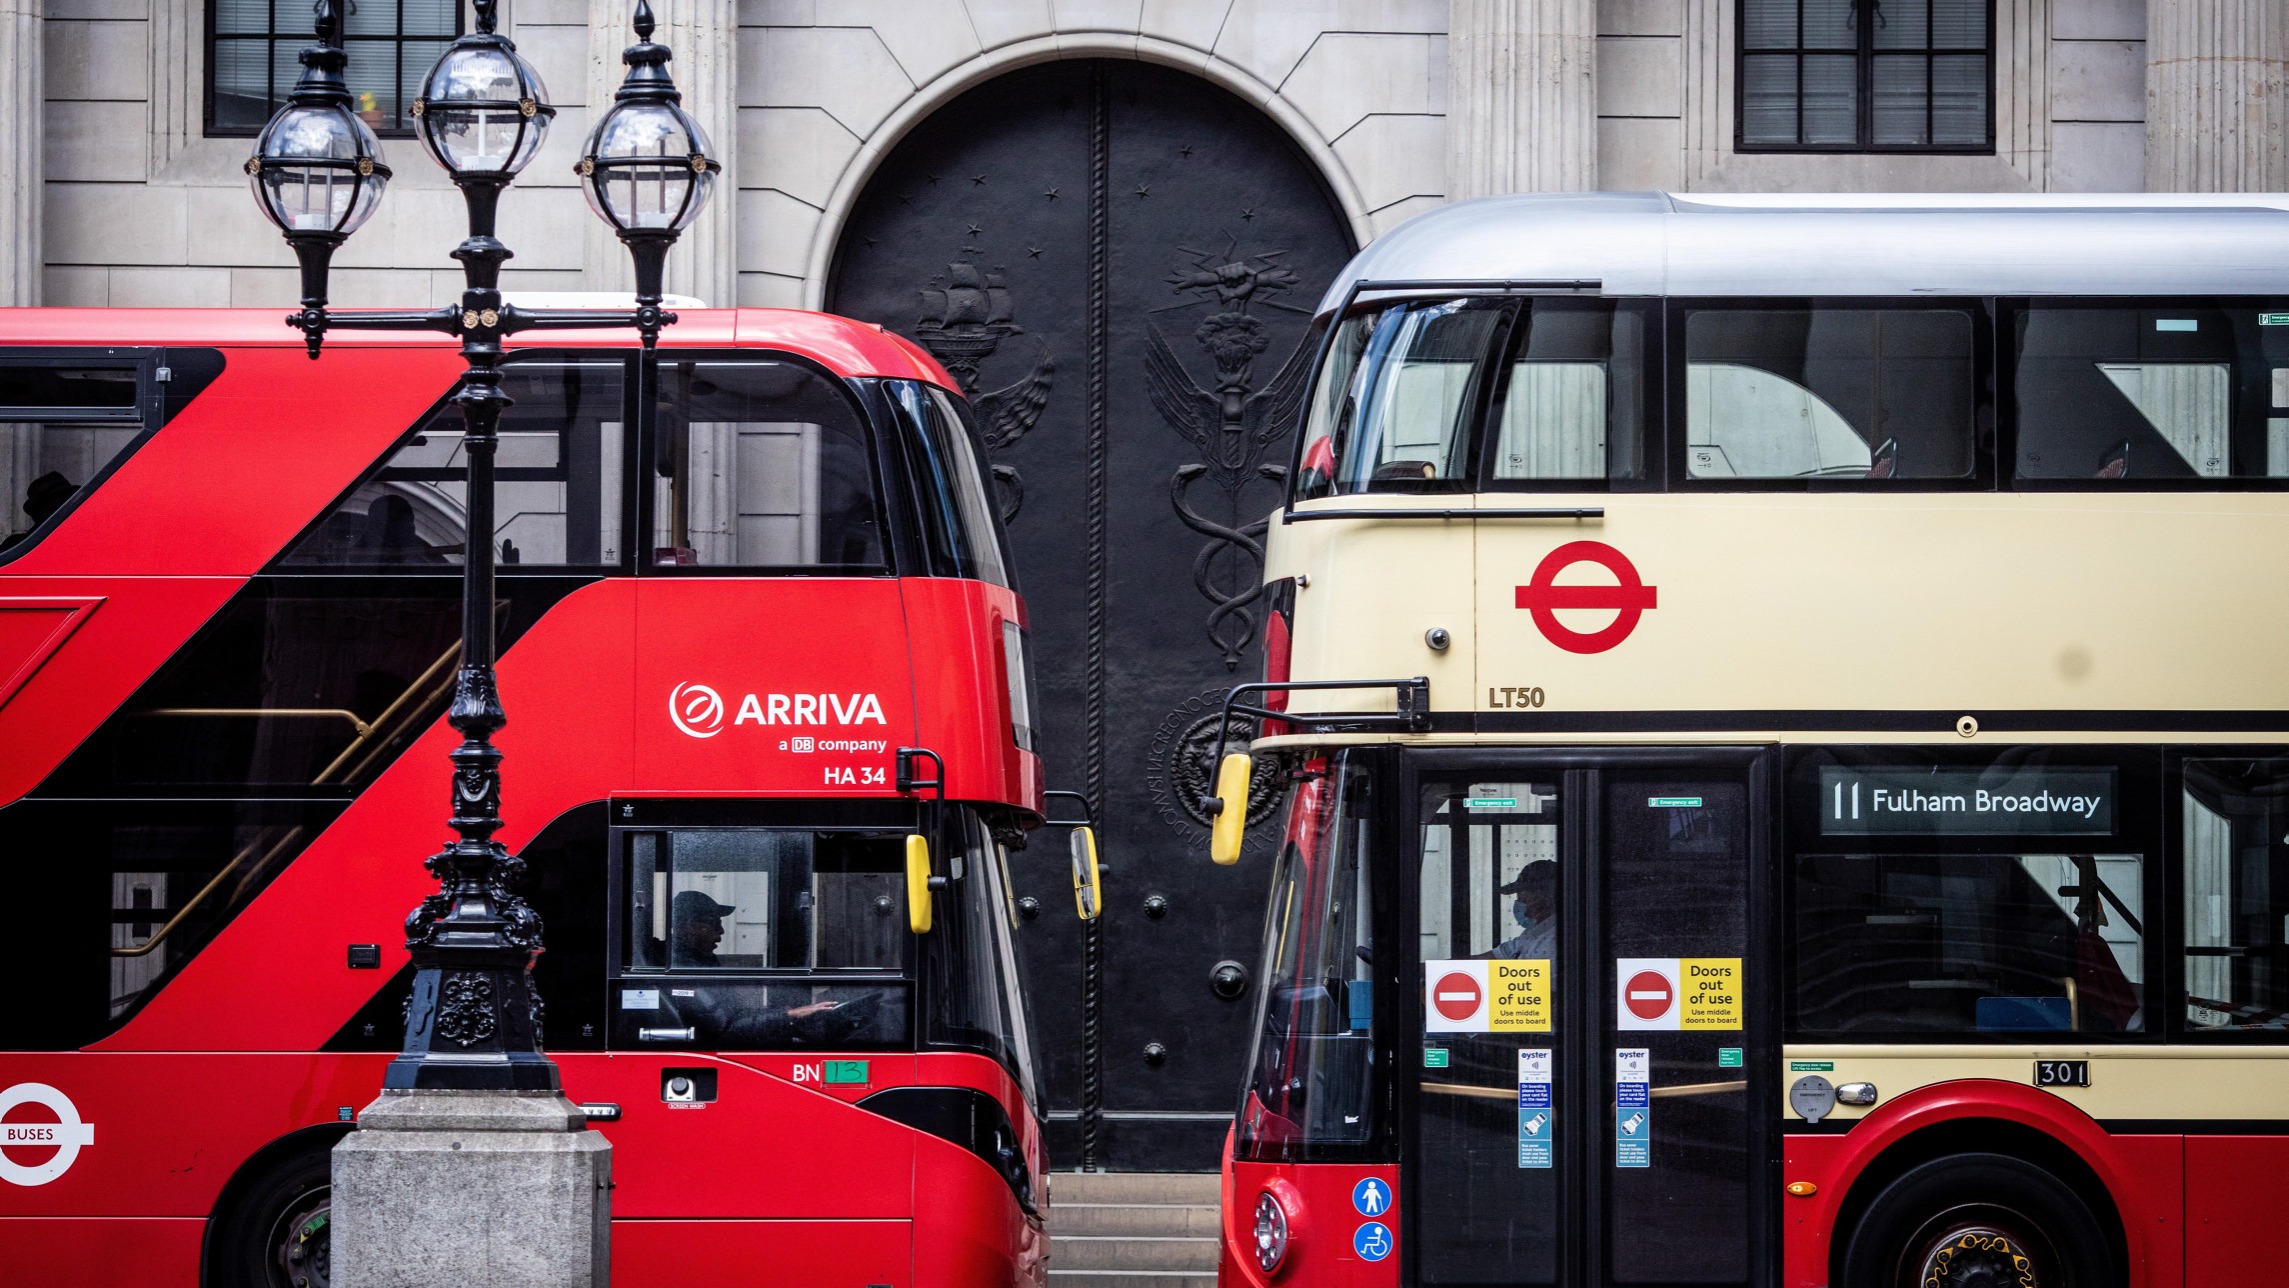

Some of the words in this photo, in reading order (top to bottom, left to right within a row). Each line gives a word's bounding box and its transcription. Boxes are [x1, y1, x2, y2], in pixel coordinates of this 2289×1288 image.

[1488, 686, 1546, 709] LT50
[733, 693, 888, 726] ARRIVA
[778, 740, 788, 751] a
[792, 738, 813, 752] DB
[818, 739, 888, 754] company
[824, 767, 856, 785] HA
[860, 767, 886, 785] 34
[1834, 781, 1859, 820] 11
[1872, 789, 1966, 812] Fulham
[1975, 789, 2101, 819] Broadway
[1499, 966, 1540, 978] Doors
[1690, 966, 1732, 976] Doors
[1508, 980, 1532, 992] out
[1699, 980, 1724, 990] out
[1498, 994, 1514, 1005] of
[1517, 996, 1542, 1005] use
[1690, 992, 1705, 1004] of
[1708, 995, 1733, 1004] use
[1521, 1052, 1548, 1060] oyster
[1618, 1051, 1645, 1060] oyster
[793, 1064, 820, 1082] BN
[834, 1062, 863, 1082] 13
[2041, 1062, 2083, 1083] 301
[8, 1128, 54, 1140] BUSES
